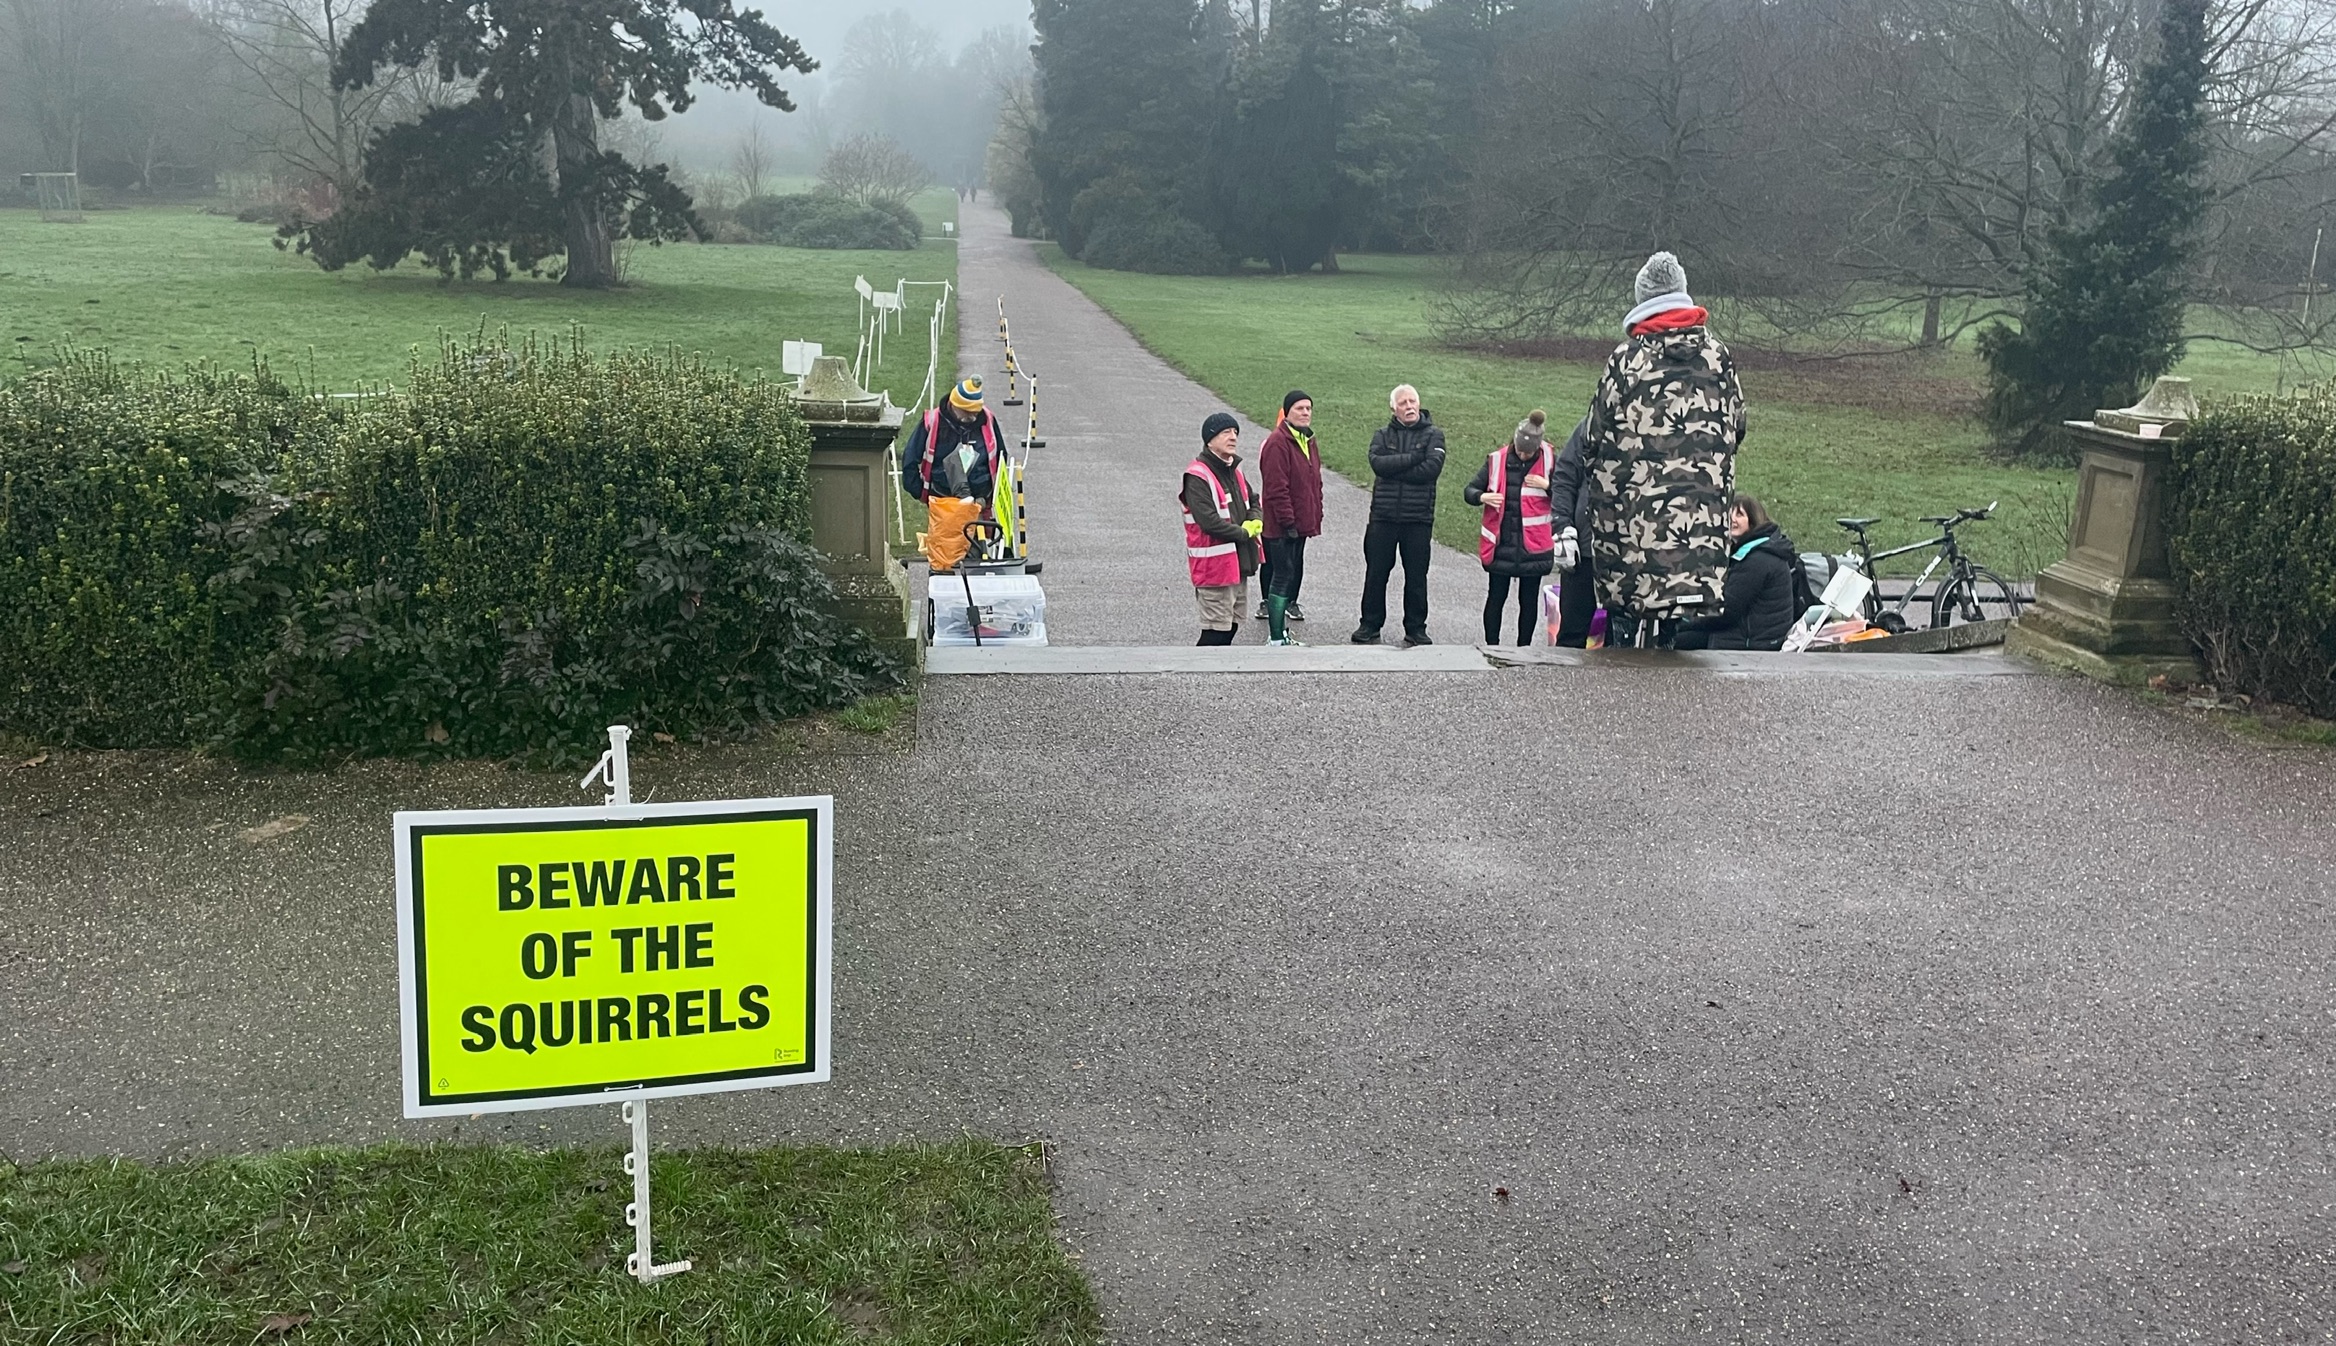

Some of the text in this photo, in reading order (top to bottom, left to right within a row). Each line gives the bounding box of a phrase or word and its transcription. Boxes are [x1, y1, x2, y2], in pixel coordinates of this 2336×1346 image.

[497, 853, 736, 911] BEWARE
[521, 922, 714, 980] OF THE
[461, 984, 770, 1055] SQUIRRELS
